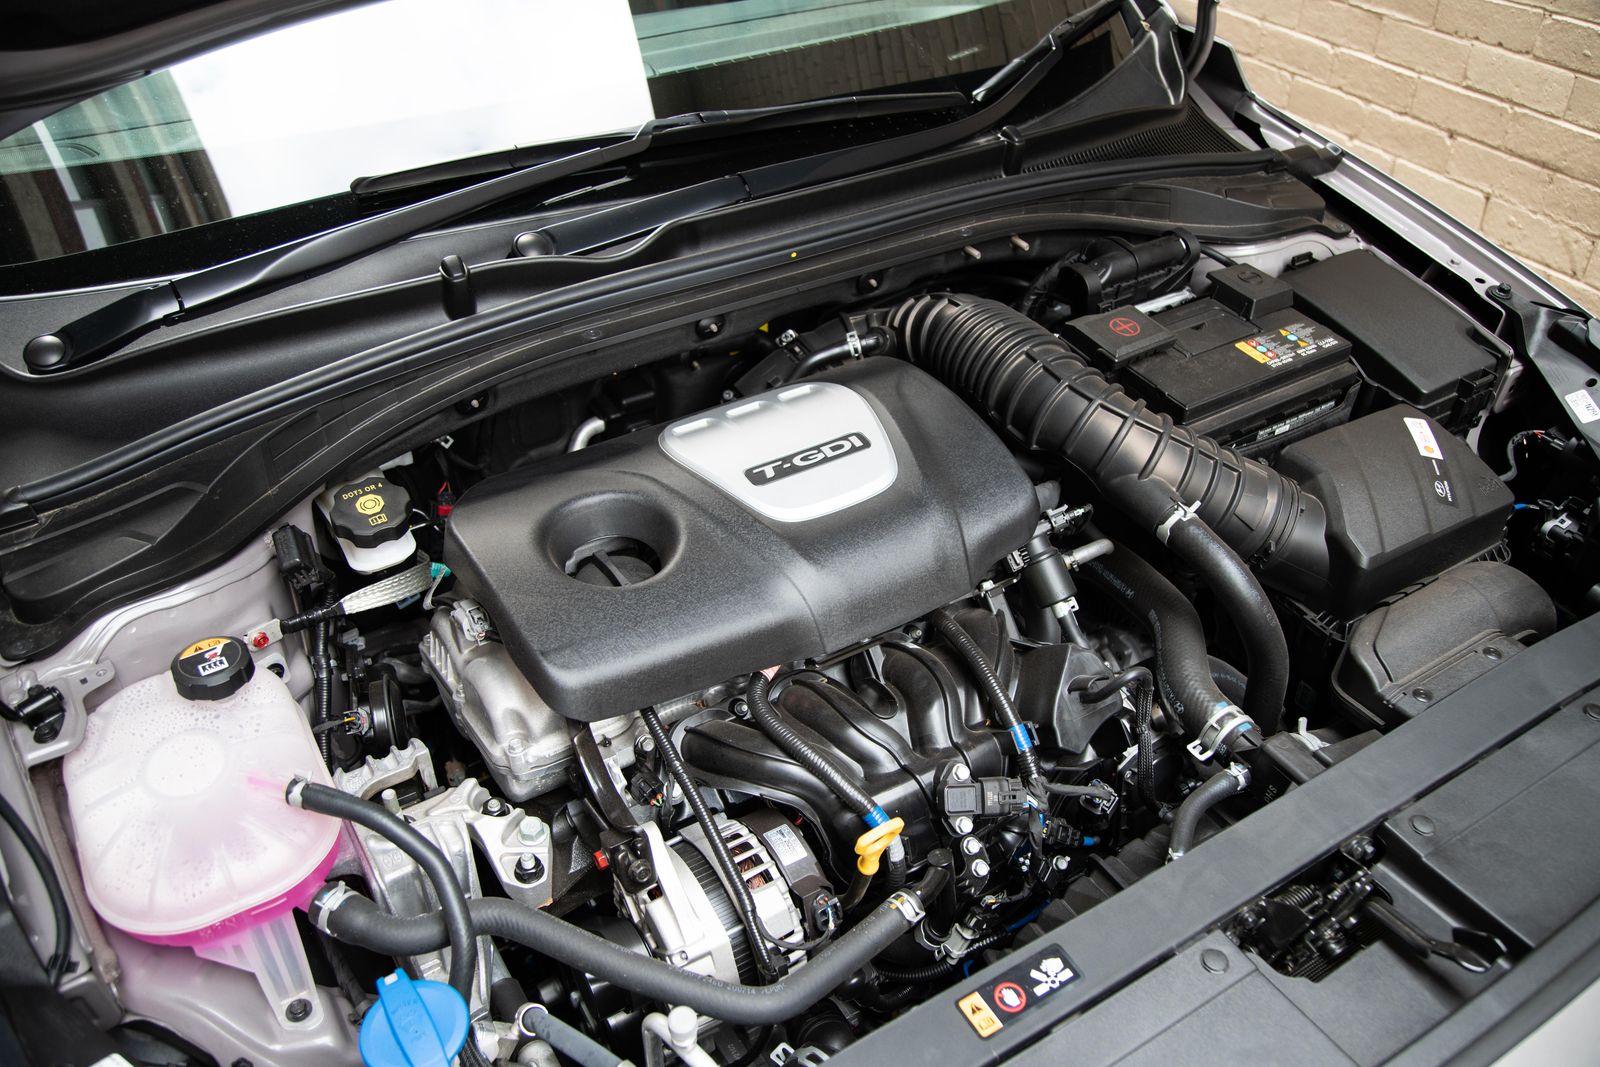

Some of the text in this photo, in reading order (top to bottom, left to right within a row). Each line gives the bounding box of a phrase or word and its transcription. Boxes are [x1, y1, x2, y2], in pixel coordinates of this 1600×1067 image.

[753, 435, 863, 479] T-GDI
[342, 489, 363, 500] DOT3
[365, 484, 377, 492] OR
